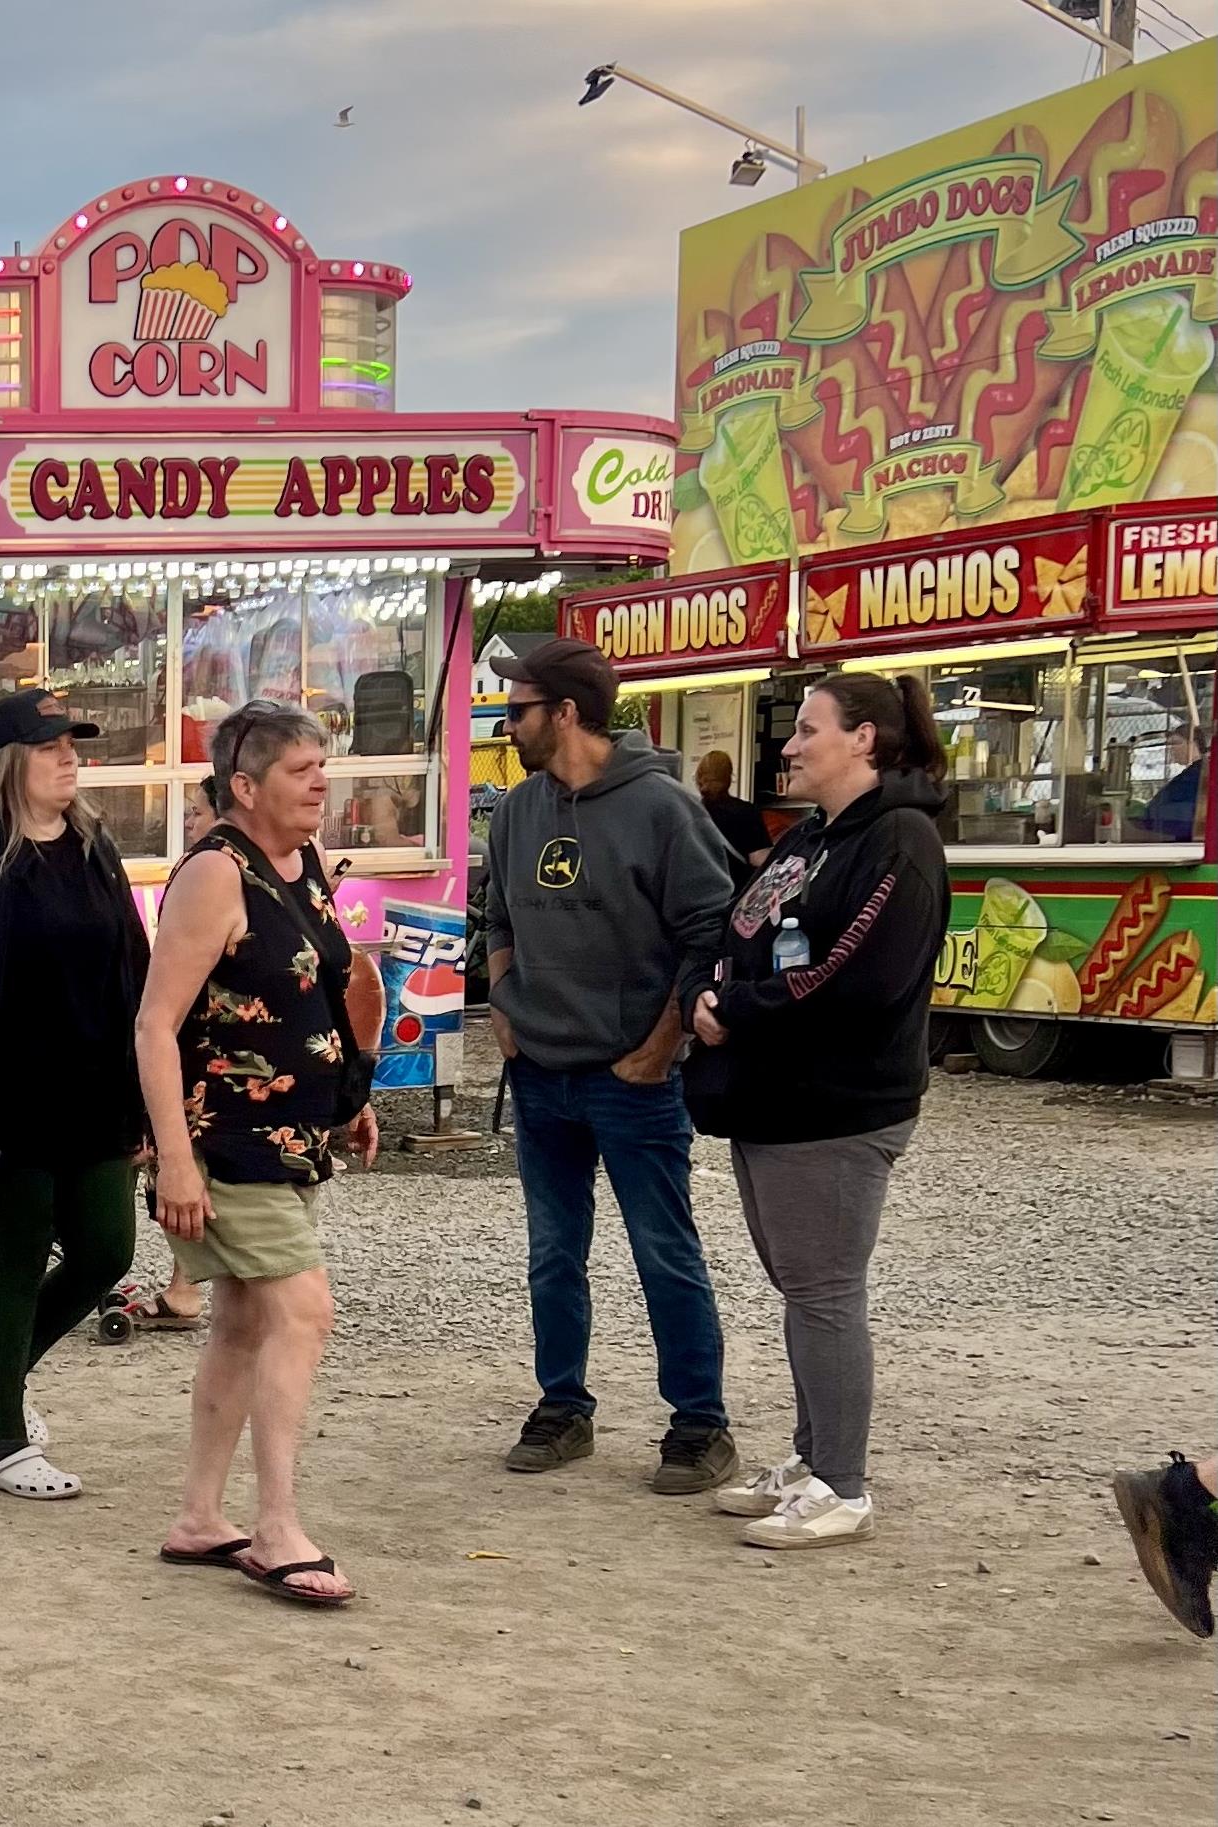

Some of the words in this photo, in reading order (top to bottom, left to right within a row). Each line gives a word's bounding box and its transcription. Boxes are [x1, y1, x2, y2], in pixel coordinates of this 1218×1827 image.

[840, 190, 939, 273] JUMBO
[946, 176, 1034, 221] DOGS
[88, 218, 269, 303] POP
[1075, 248, 1216, 312] LEMONADE
[89, 339, 268, 397] CORN
[700, 367, 796, 415] LEMONADE
[1096, 350, 1123, 390] Fresh
[1120, 374, 1186, 410] Lemonade
[30, 456, 240, 521] CANDY
[274, 454, 496, 518] APPLES
[587, 448, 674, 505] Cold
[873, 452, 969, 492] NACHOS
[1122, 520, 1218, 551] FRESH
[859, 545, 1021, 631] NACHOS
[595, 599, 665, 660] CORN
[670, 587, 748, 650] DOGS
